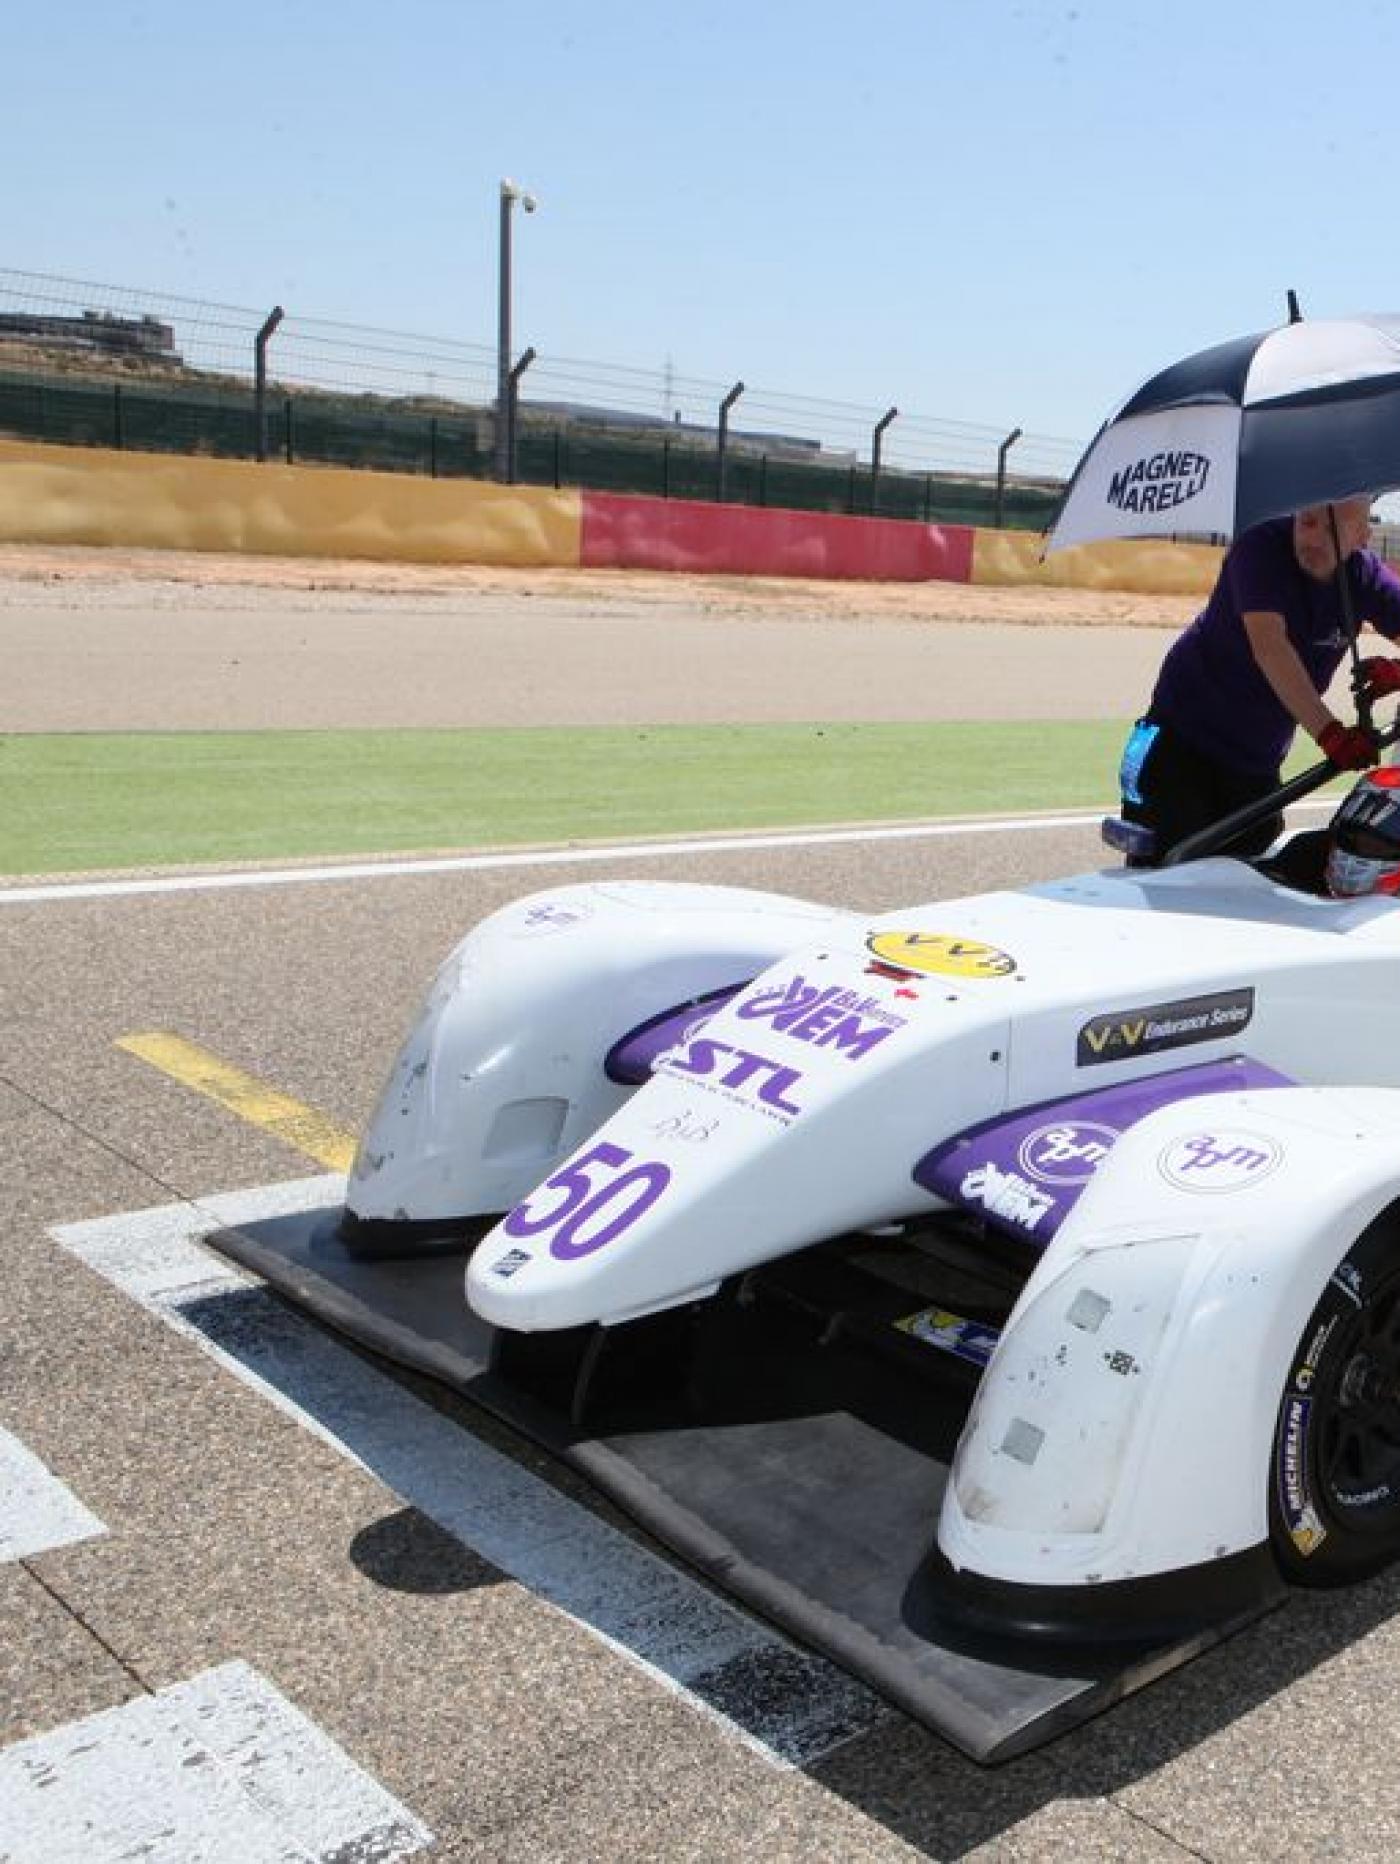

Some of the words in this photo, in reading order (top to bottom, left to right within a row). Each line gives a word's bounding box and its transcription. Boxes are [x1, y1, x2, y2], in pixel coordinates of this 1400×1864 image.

[1107, 472, 1209, 514] MARELLI
[1108, 450, 1211, 494] MAGNETI
[1145, 1012, 1210, 1041] Endurance
[669, 1038, 802, 1116] STL
[500, 1141, 672, 1262] 50
